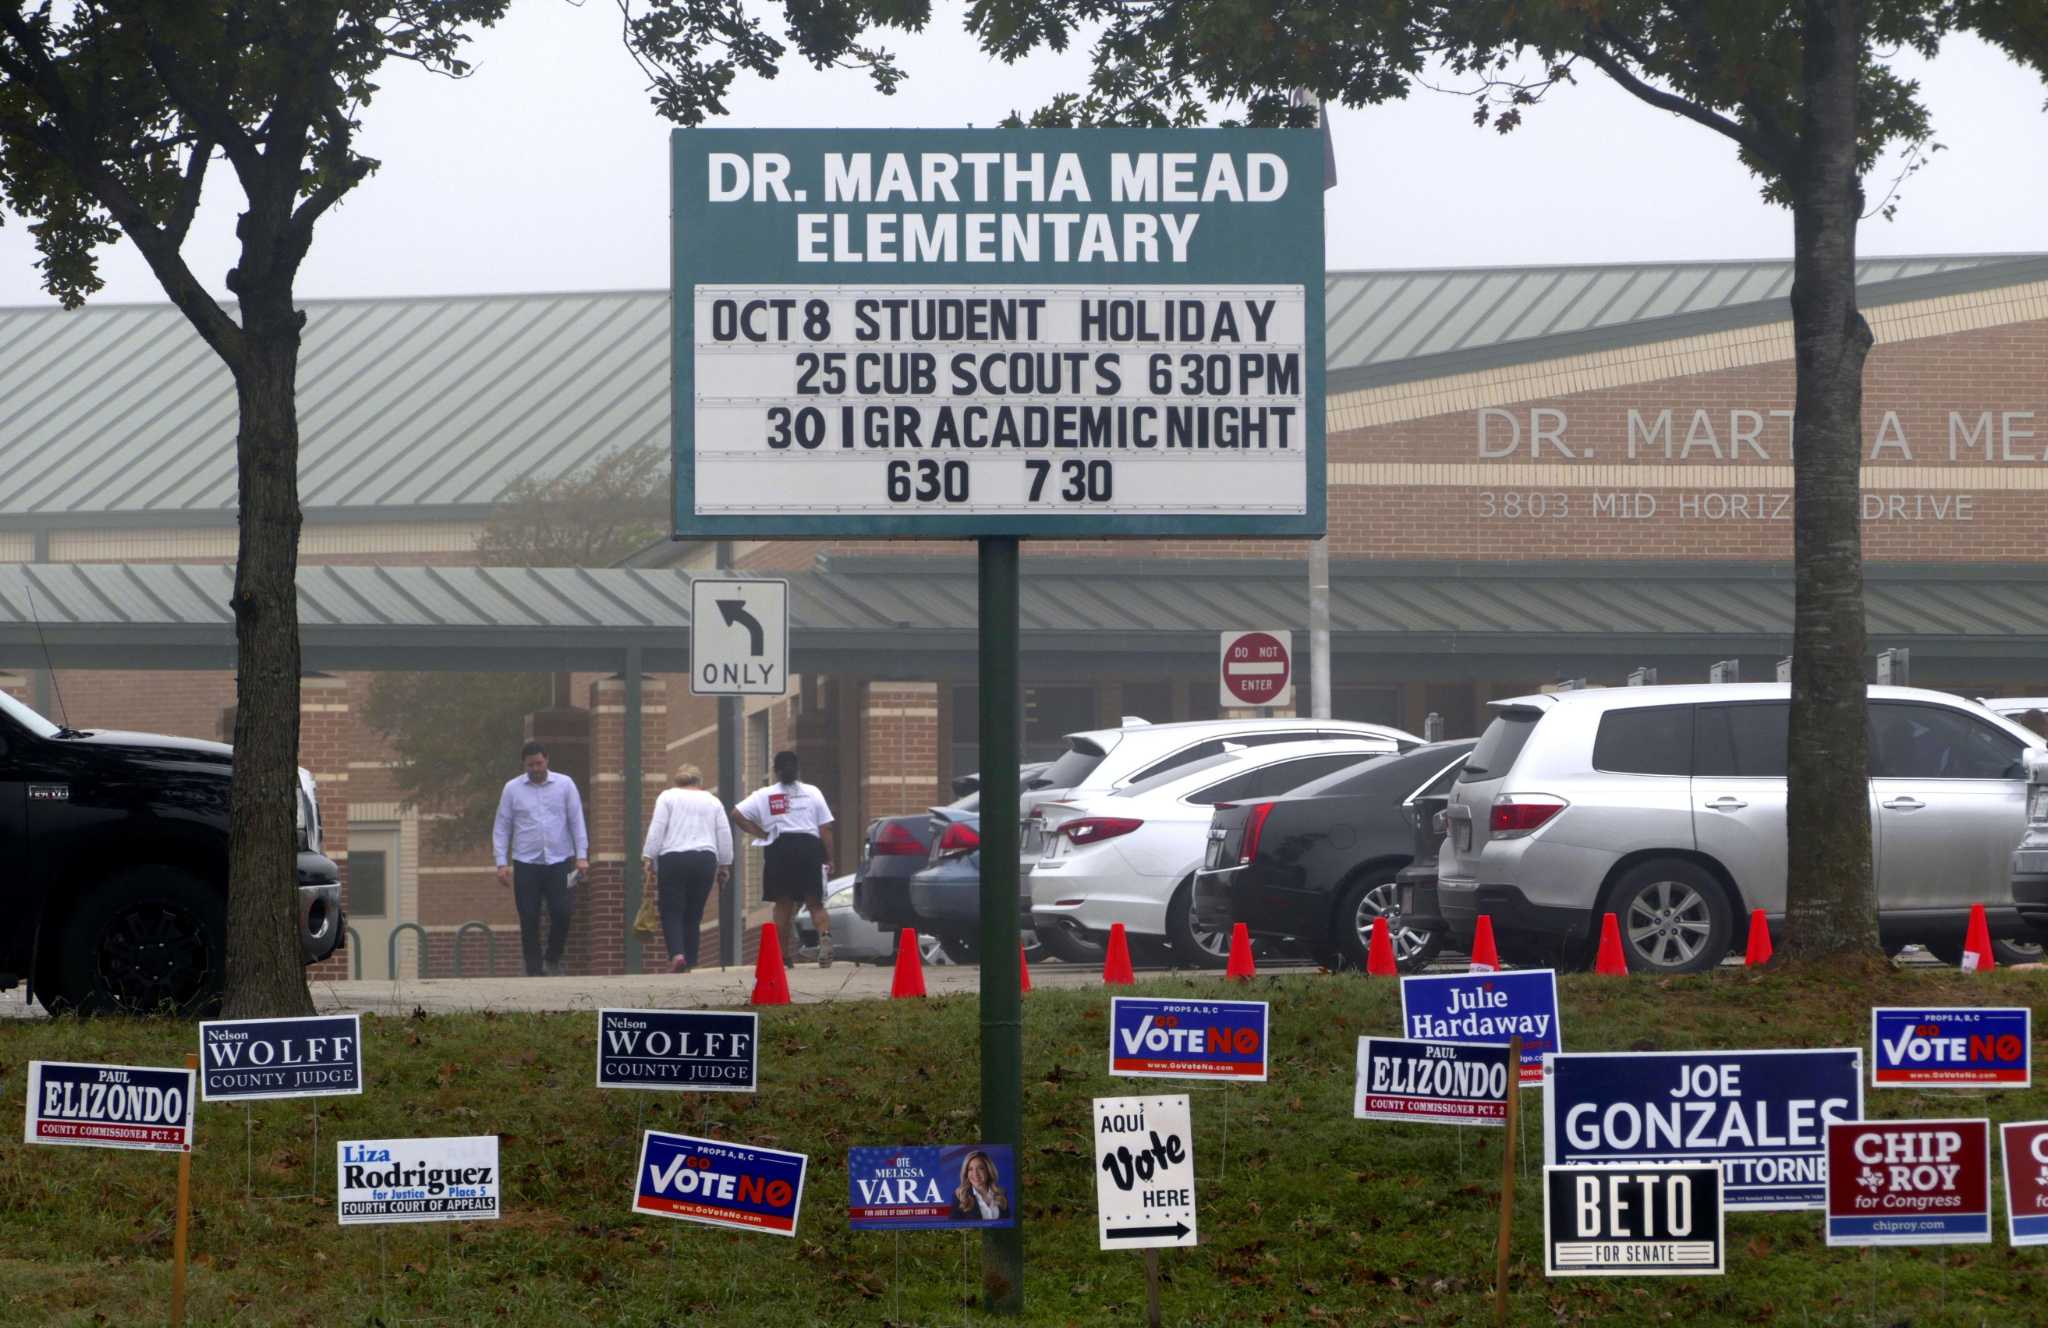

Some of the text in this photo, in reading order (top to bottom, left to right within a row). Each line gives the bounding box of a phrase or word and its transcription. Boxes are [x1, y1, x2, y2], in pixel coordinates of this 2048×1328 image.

[708, 152, 1289, 202] DR. MARTHA MEAD
[797, 213, 1200, 262] ELEMENTARY
[712, 298, 1276, 342] OCT 8 STUDENT HOLIDAY
[796, 352, 847, 395] 25
[856, 352, 937, 395] CUB
[950, 352, 1122, 396] SCOUTS
[767, 406, 826, 449] 30
[931, 405, 1158, 449] ACADEMIC
[1166, 405, 1296, 449] NIGHT
[1477, 407, 2048, 461] DR. MARTA ME
[887, 459, 1113, 502] 630 730
[1479, 493, 1569, 519] 3803
[1592, 493, 1657, 519] MID
[1861, 495, 1974, 521] DRIVE
[1234, 646, 1279, 659] DO NOT
[703, 663, 774, 685] ONLY
[1241, 679, 1273, 692] ENTER
[1164, 1005, 1191, 1013] PROPS
[1446, 982, 1508, 1014] Julie
[208, 1029, 248, 1041] Nelson
[607, 1017, 647, 1029] Nelson
[1120, 1015, 1259, 1055] VOTE NO
[1412, 1013, 1551, 1039] Hardaway
[208, 1036, 353, 1067] WOLFF
[606, 1030, 750, 1058] WOLFF
[1425, 1046, 1457, 1059] PAUL
[1882, 1025, 2022, 1066] VOTE NO
[98, 1070, 130, 1083] PAUL
[209, 1069, 354, 1088] COUNTY JUDGE
[605, 1062, 749, 1081] COUNTY JUDGE
[1372, 1056, 1507, 1099] ELIZONDO
[1669, 1064, 1741, 1098] JOE
[43, 1081, 183, 1124] ELIZONDO
[1370, 1099, 1505, 1115] COUNTY COMMISSIONER PCT. 2
[41, 1124, 180, 1141] COUNTY COMMISSIONER PCT. 2
[343, 1144, 391, 1163] Liza
[697, 1146, 726, 1157] PROPS
[1854, 1131, 1962, 1164] CHIP
[875, 1168, 924, 1178] MELISSA
[1102, 1131, 1186, 1191] Vote
[343, 1160, 493, 1195] Rodriguez
[650, 1153, 793, 1208] VOTE NO
[1888, 1165, 1961, 1191] ROY
[372, 1186, 486, 1200] for Justice Place 5
[857, 1178, 944, 1204] VARA
[1143, 1189, 1190, 1208] HERE
[1855, 1193, 1962, 1210] for Congress
[343, 1198, 494, 1214] FOURTH COURT OF APPEALS
[1576, 1175, 1692, 1237] BETO
[1873, 1220, 1945, 1233] chiproy.com
[1596, 1245, 1675, 1262] FOR SENATE
